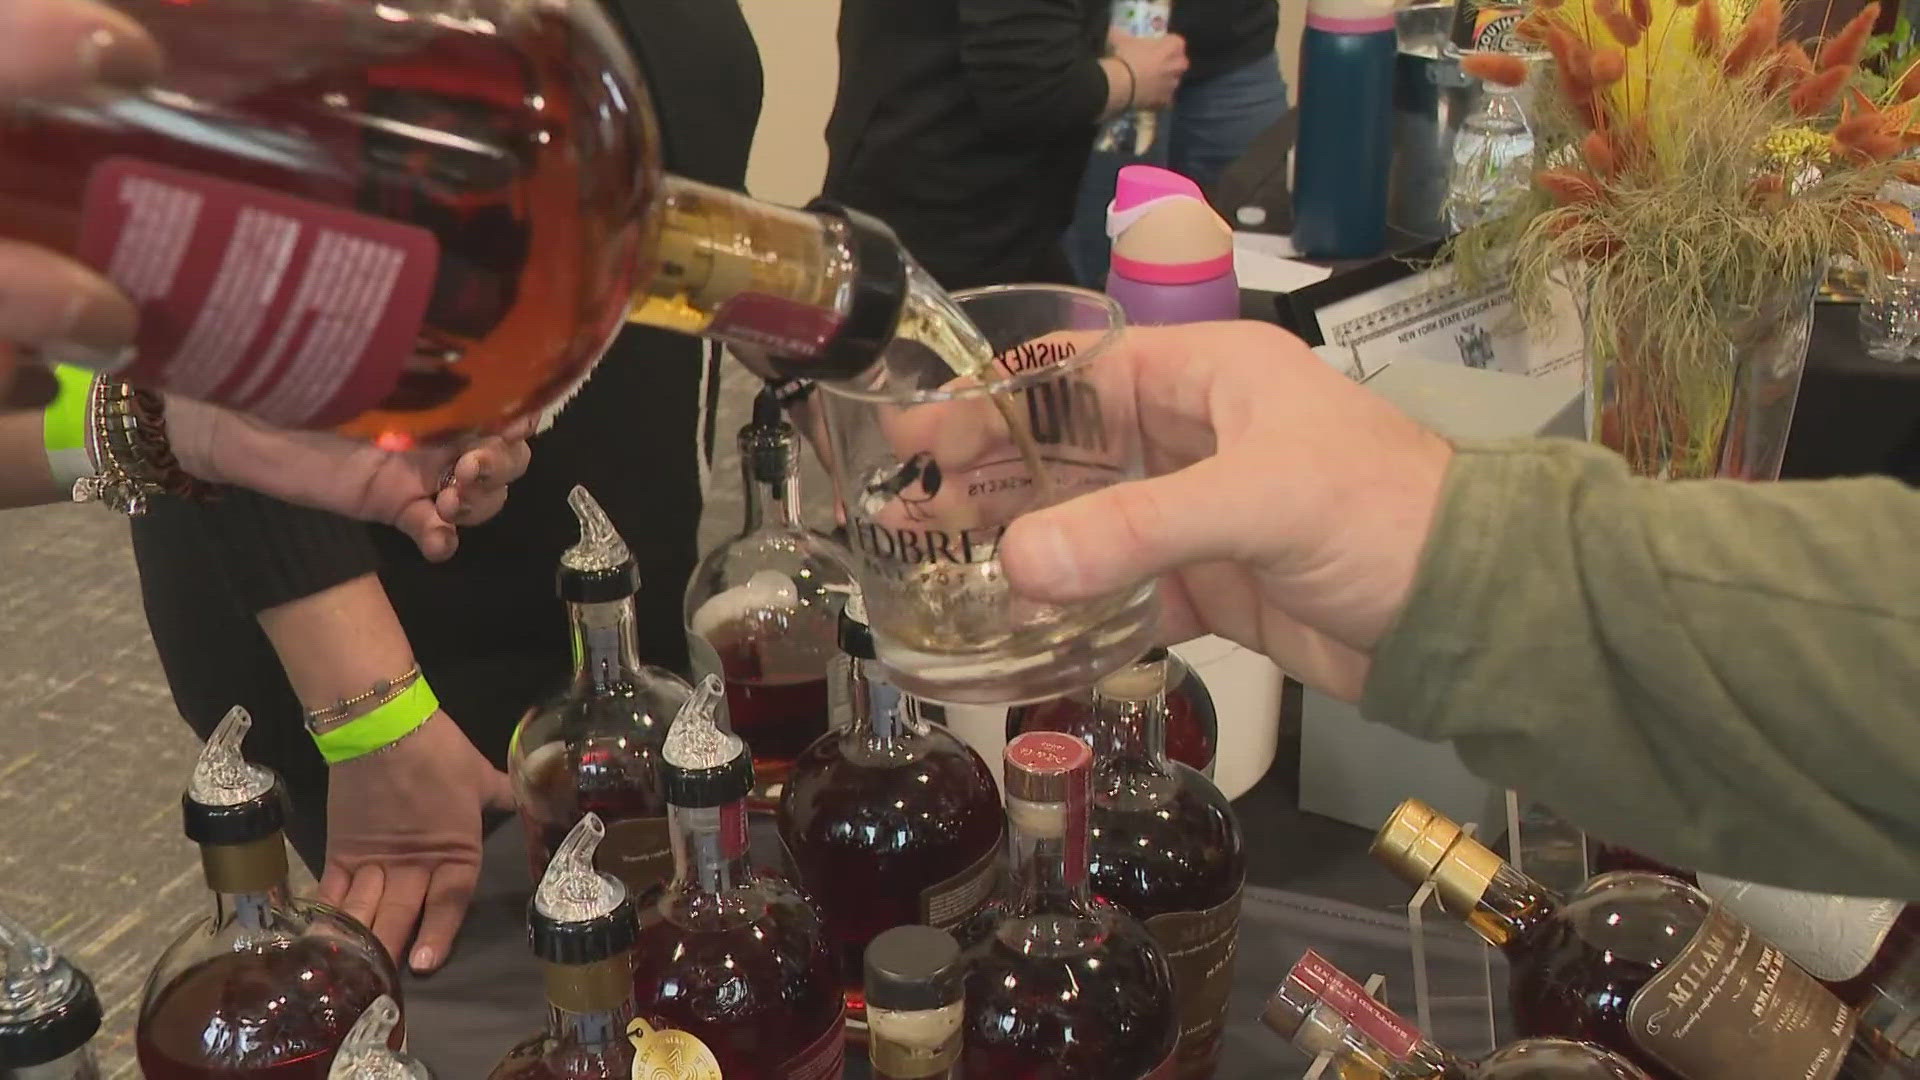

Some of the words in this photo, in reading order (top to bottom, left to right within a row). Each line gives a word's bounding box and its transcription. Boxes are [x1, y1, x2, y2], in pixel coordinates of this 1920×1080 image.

[1398, 331, 1416, 343] NEW
[1418, 320, 1437, 336] YORK
[1438, 313, 1460, 328] STATE
[1461, 301, 1489, 319] LIQUOR
[1345, 986, 1359, 999] IN
[1357, 997, 1408, 1039] BOTTLED
